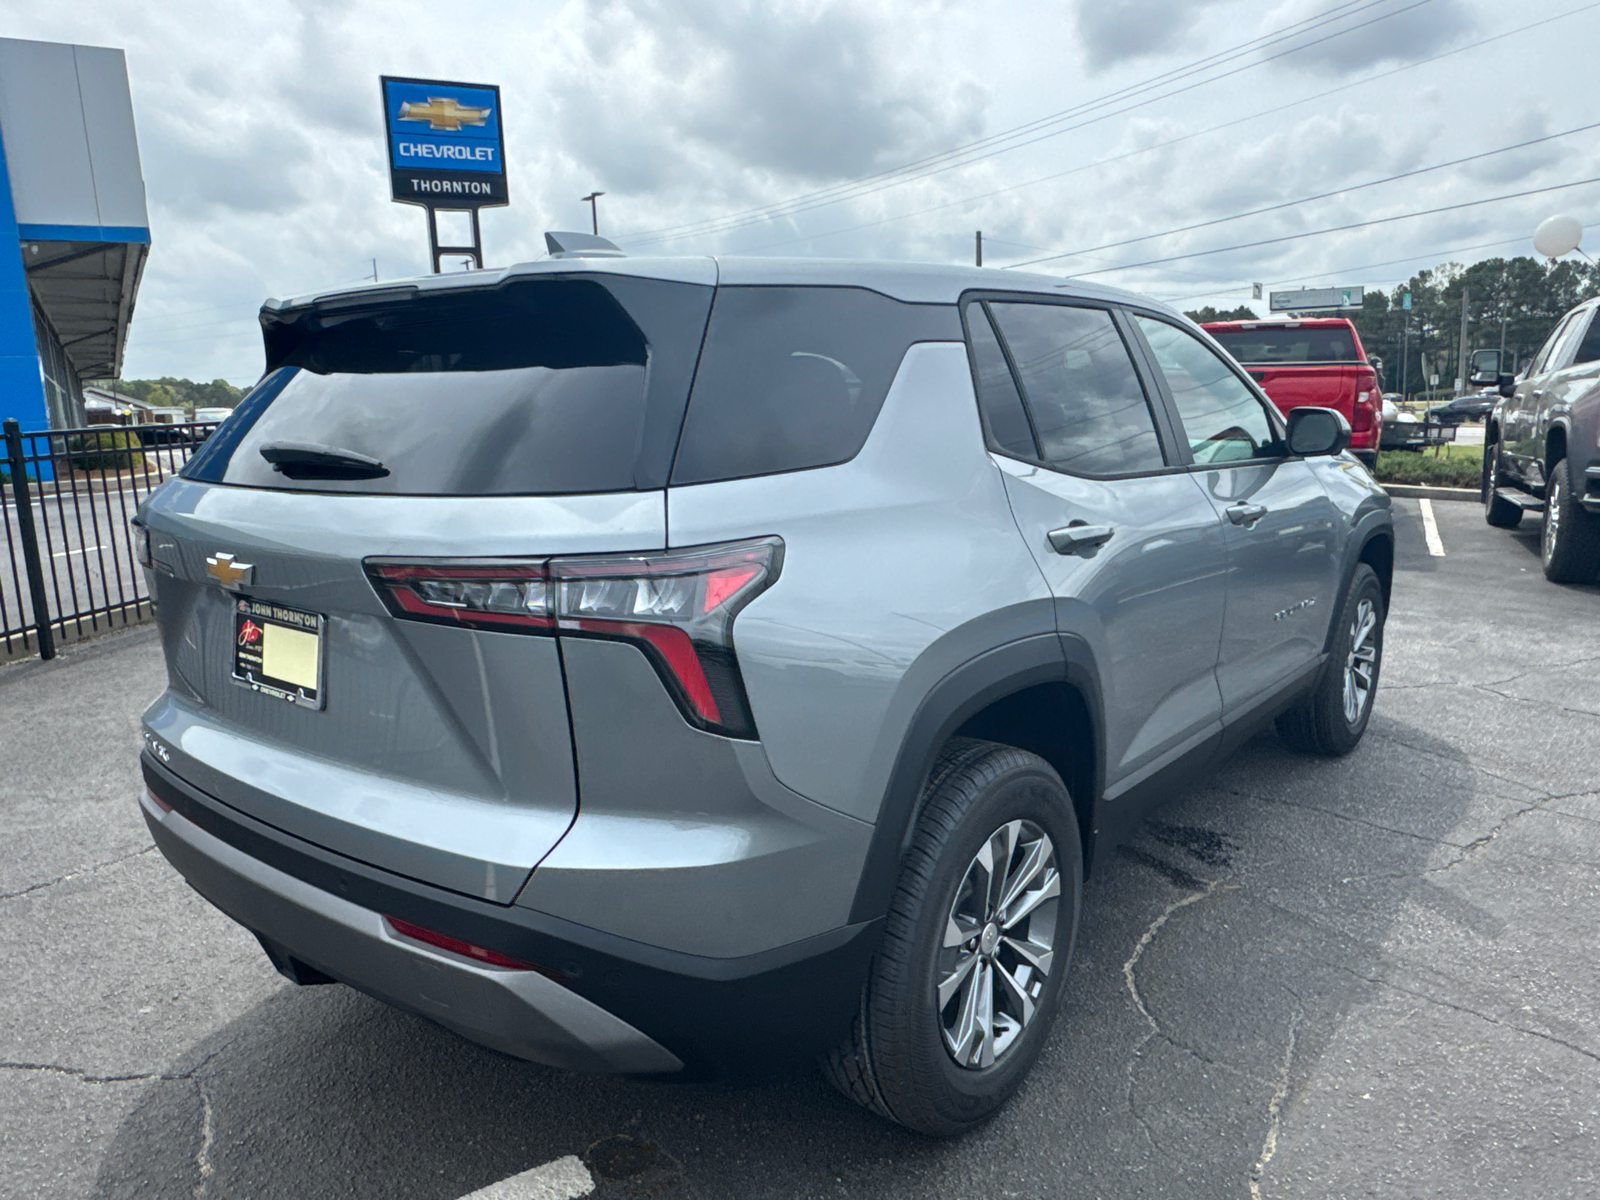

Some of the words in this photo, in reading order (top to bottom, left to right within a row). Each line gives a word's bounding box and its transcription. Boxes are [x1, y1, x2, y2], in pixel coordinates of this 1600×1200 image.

[399, 142, 495, 161] CHEVROLET
[411, 179, 491, 194] THORNTON
[251, 603, 272, 617] JOHN
[273, 607, 317, 628] THORNTON
